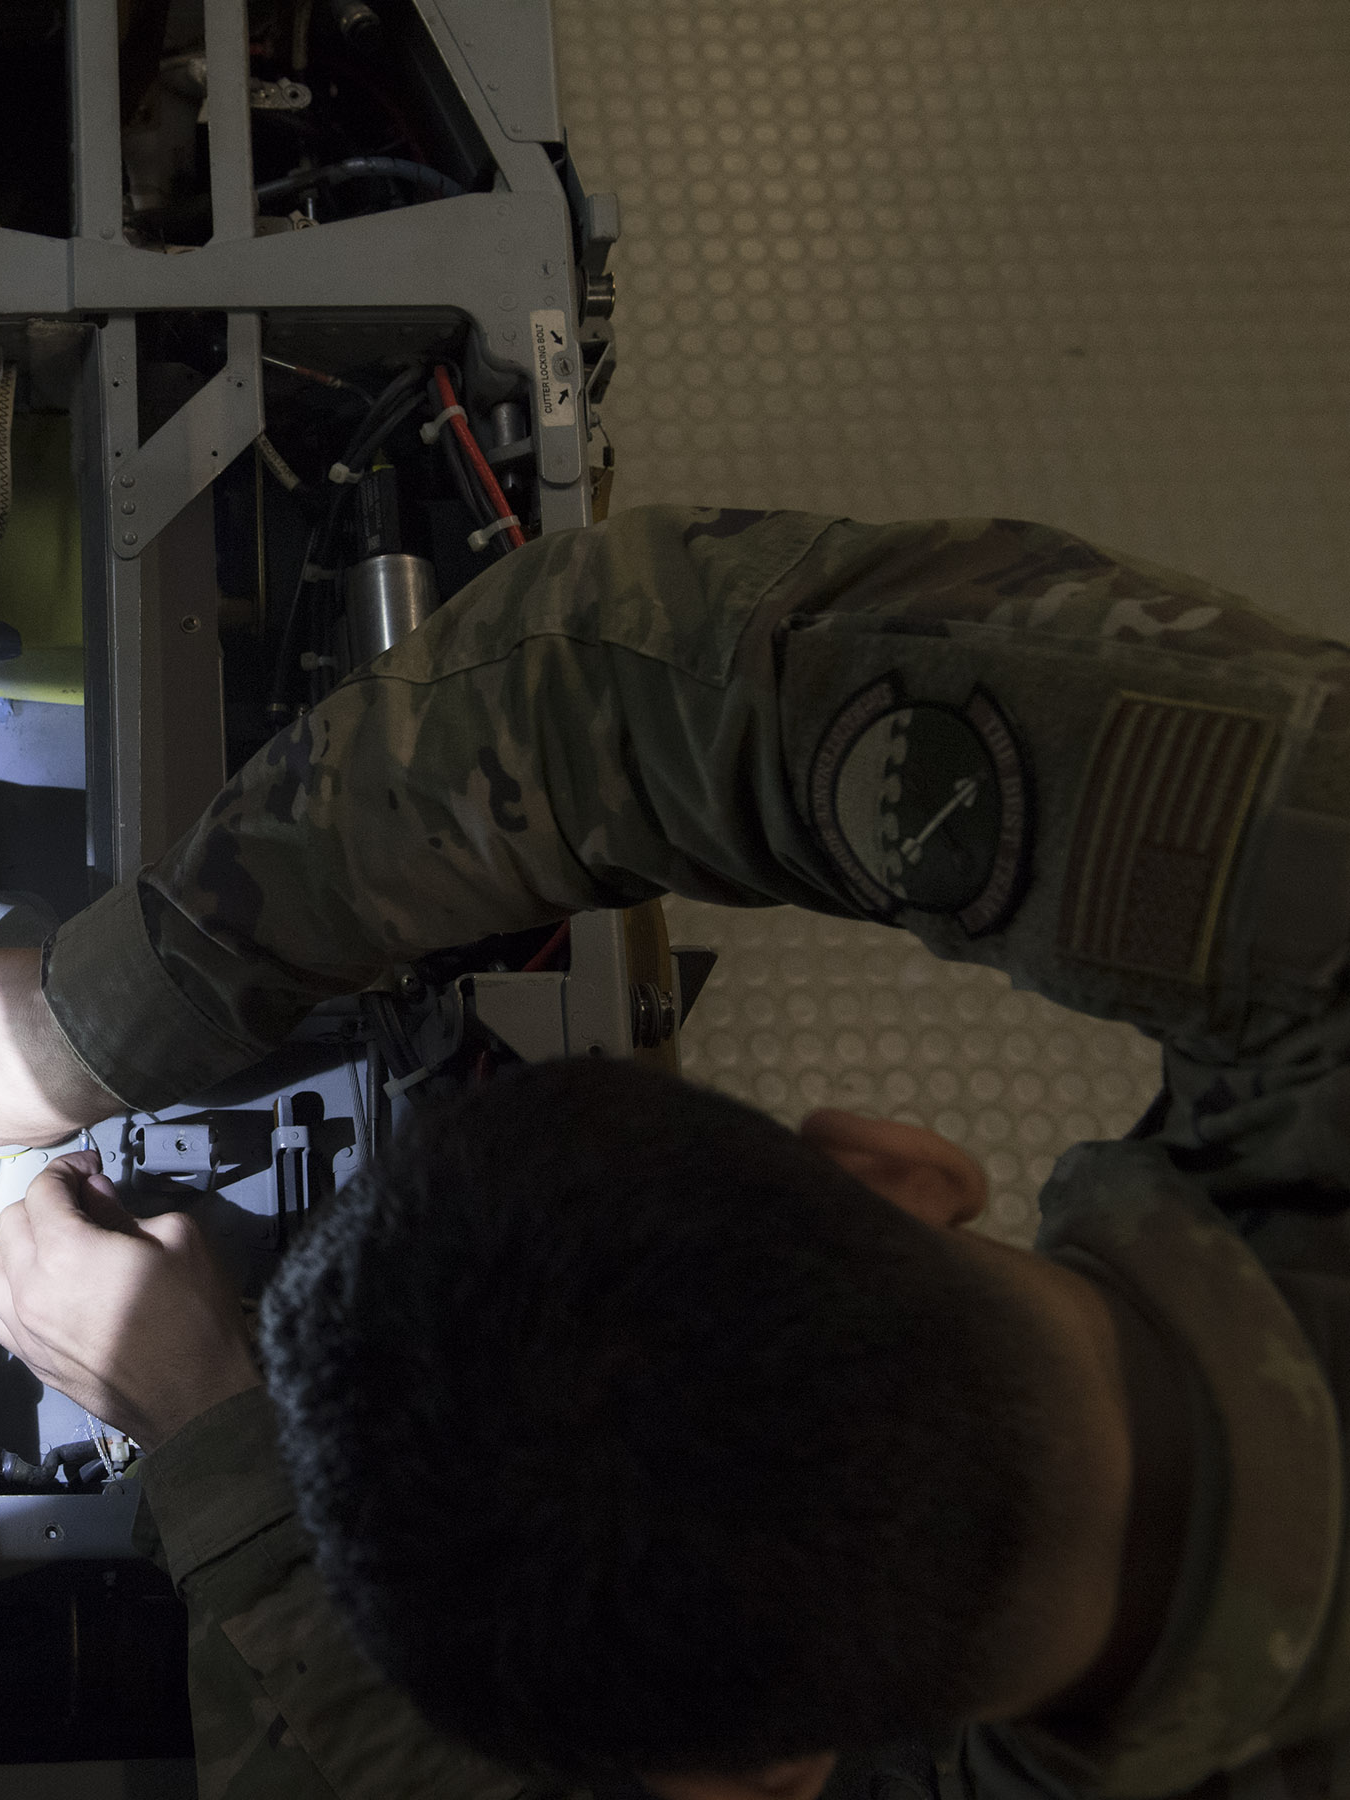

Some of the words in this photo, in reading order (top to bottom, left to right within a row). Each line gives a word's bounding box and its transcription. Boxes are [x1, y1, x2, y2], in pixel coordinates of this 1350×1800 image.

[536, 324, 545, 343] BOLT
[538, 345, 549, 381] LOCKING
[542, 382, 553, 413] CUTTER
